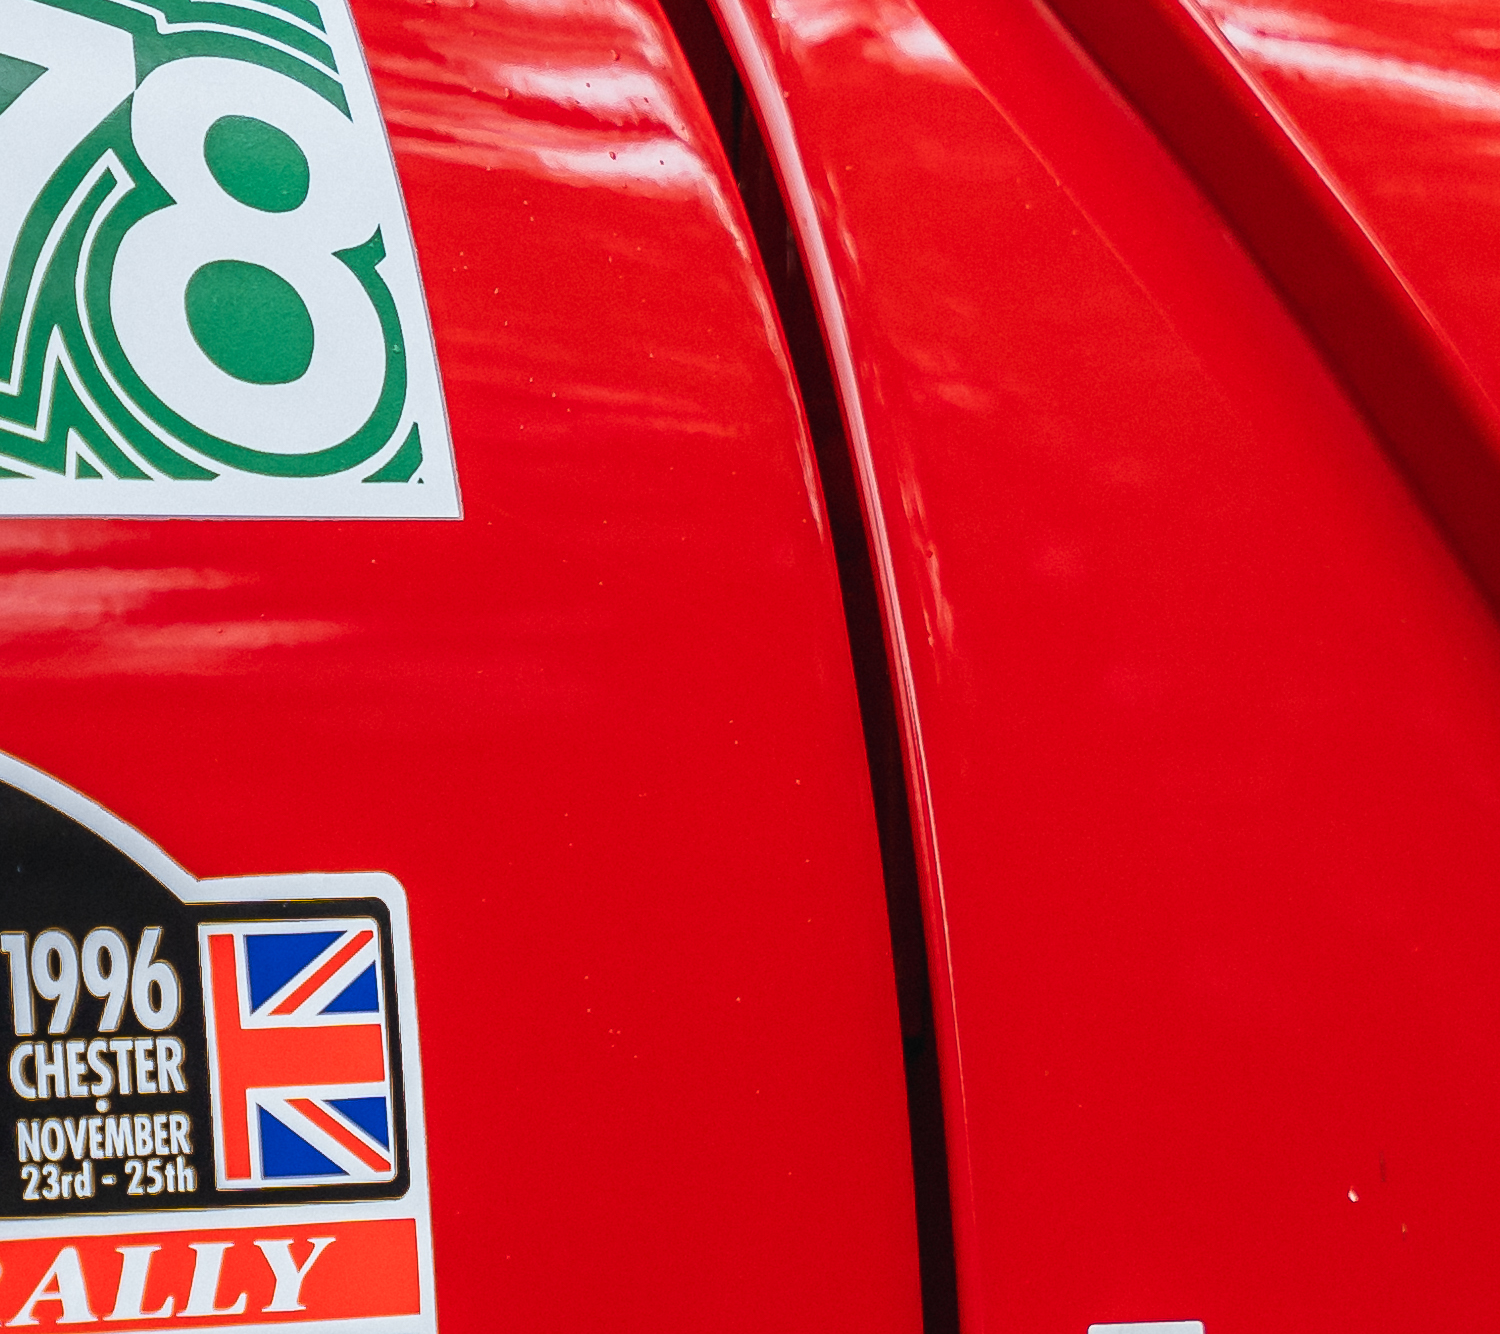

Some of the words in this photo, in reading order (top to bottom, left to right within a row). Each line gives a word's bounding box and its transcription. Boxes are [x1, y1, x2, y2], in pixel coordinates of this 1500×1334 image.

[0, 925, 181, 1037] 1996
[9, 1036, 188, 1100] CHESTER
[15, 1110, 194, 1163] NOVEMBER
[20, 1159, 96, 1200] 23rd
[124, 1154, 198, 1196] 25th
